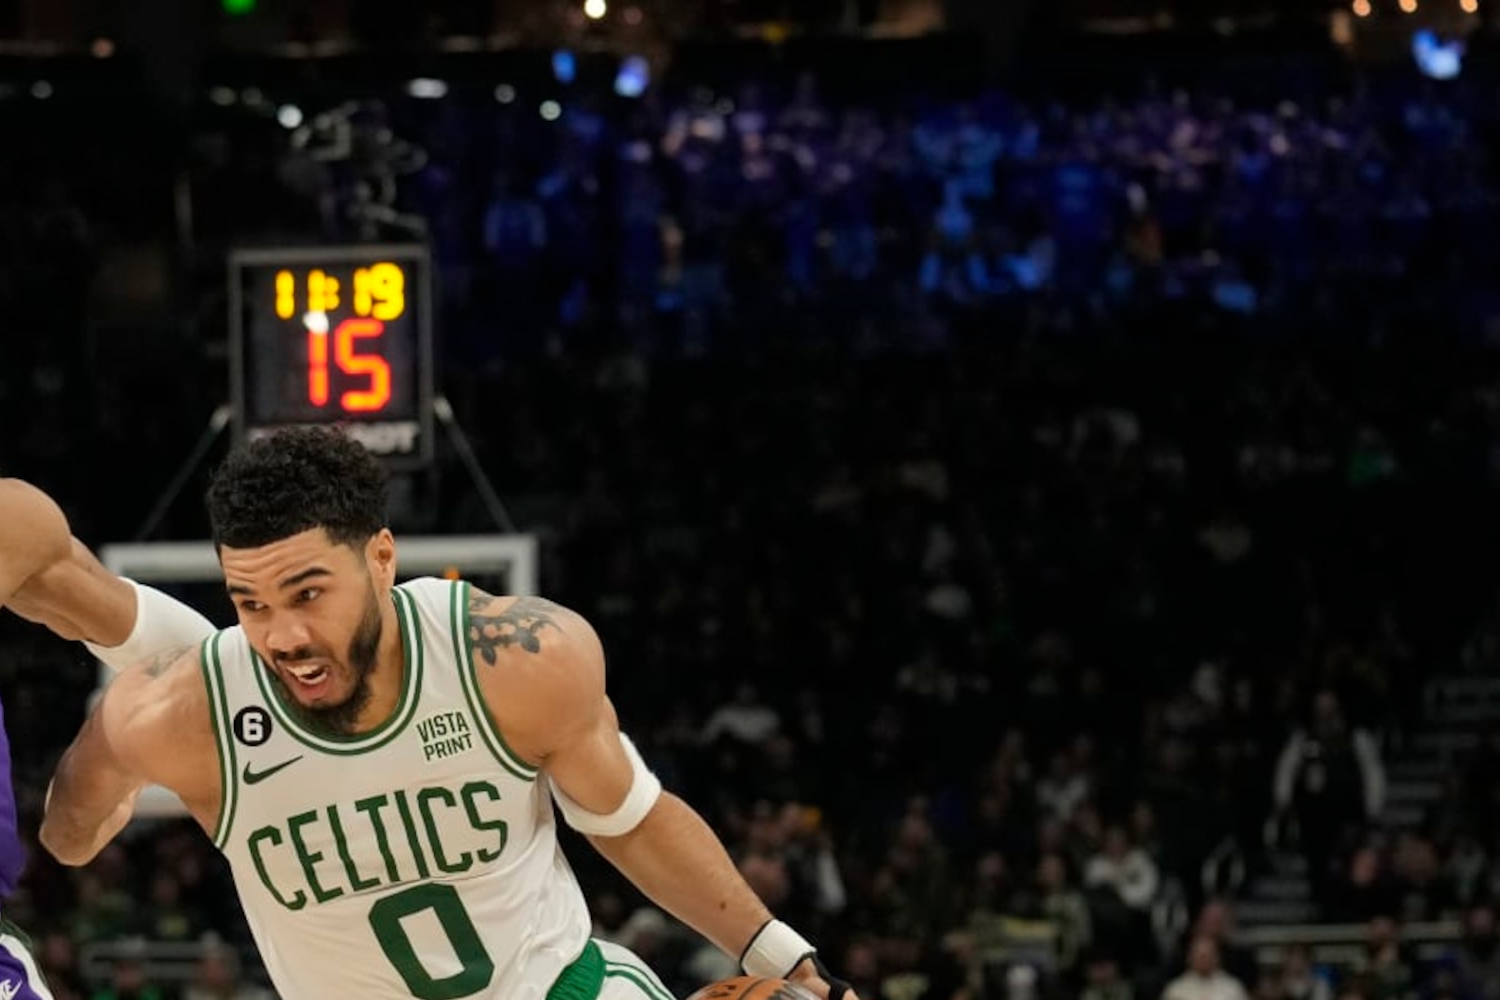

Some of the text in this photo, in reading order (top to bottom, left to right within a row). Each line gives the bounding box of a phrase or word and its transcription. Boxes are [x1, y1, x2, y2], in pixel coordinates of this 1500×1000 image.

[275, 262, 405, 320] 11:19
[307, 317, 391, 411] 15
[242, 712, 265, 743] 6
[416, 711, 470, 743] VISTA
[423, 733, 473, 761] PRINT
[247, 780, 508, 911] CELTICS
